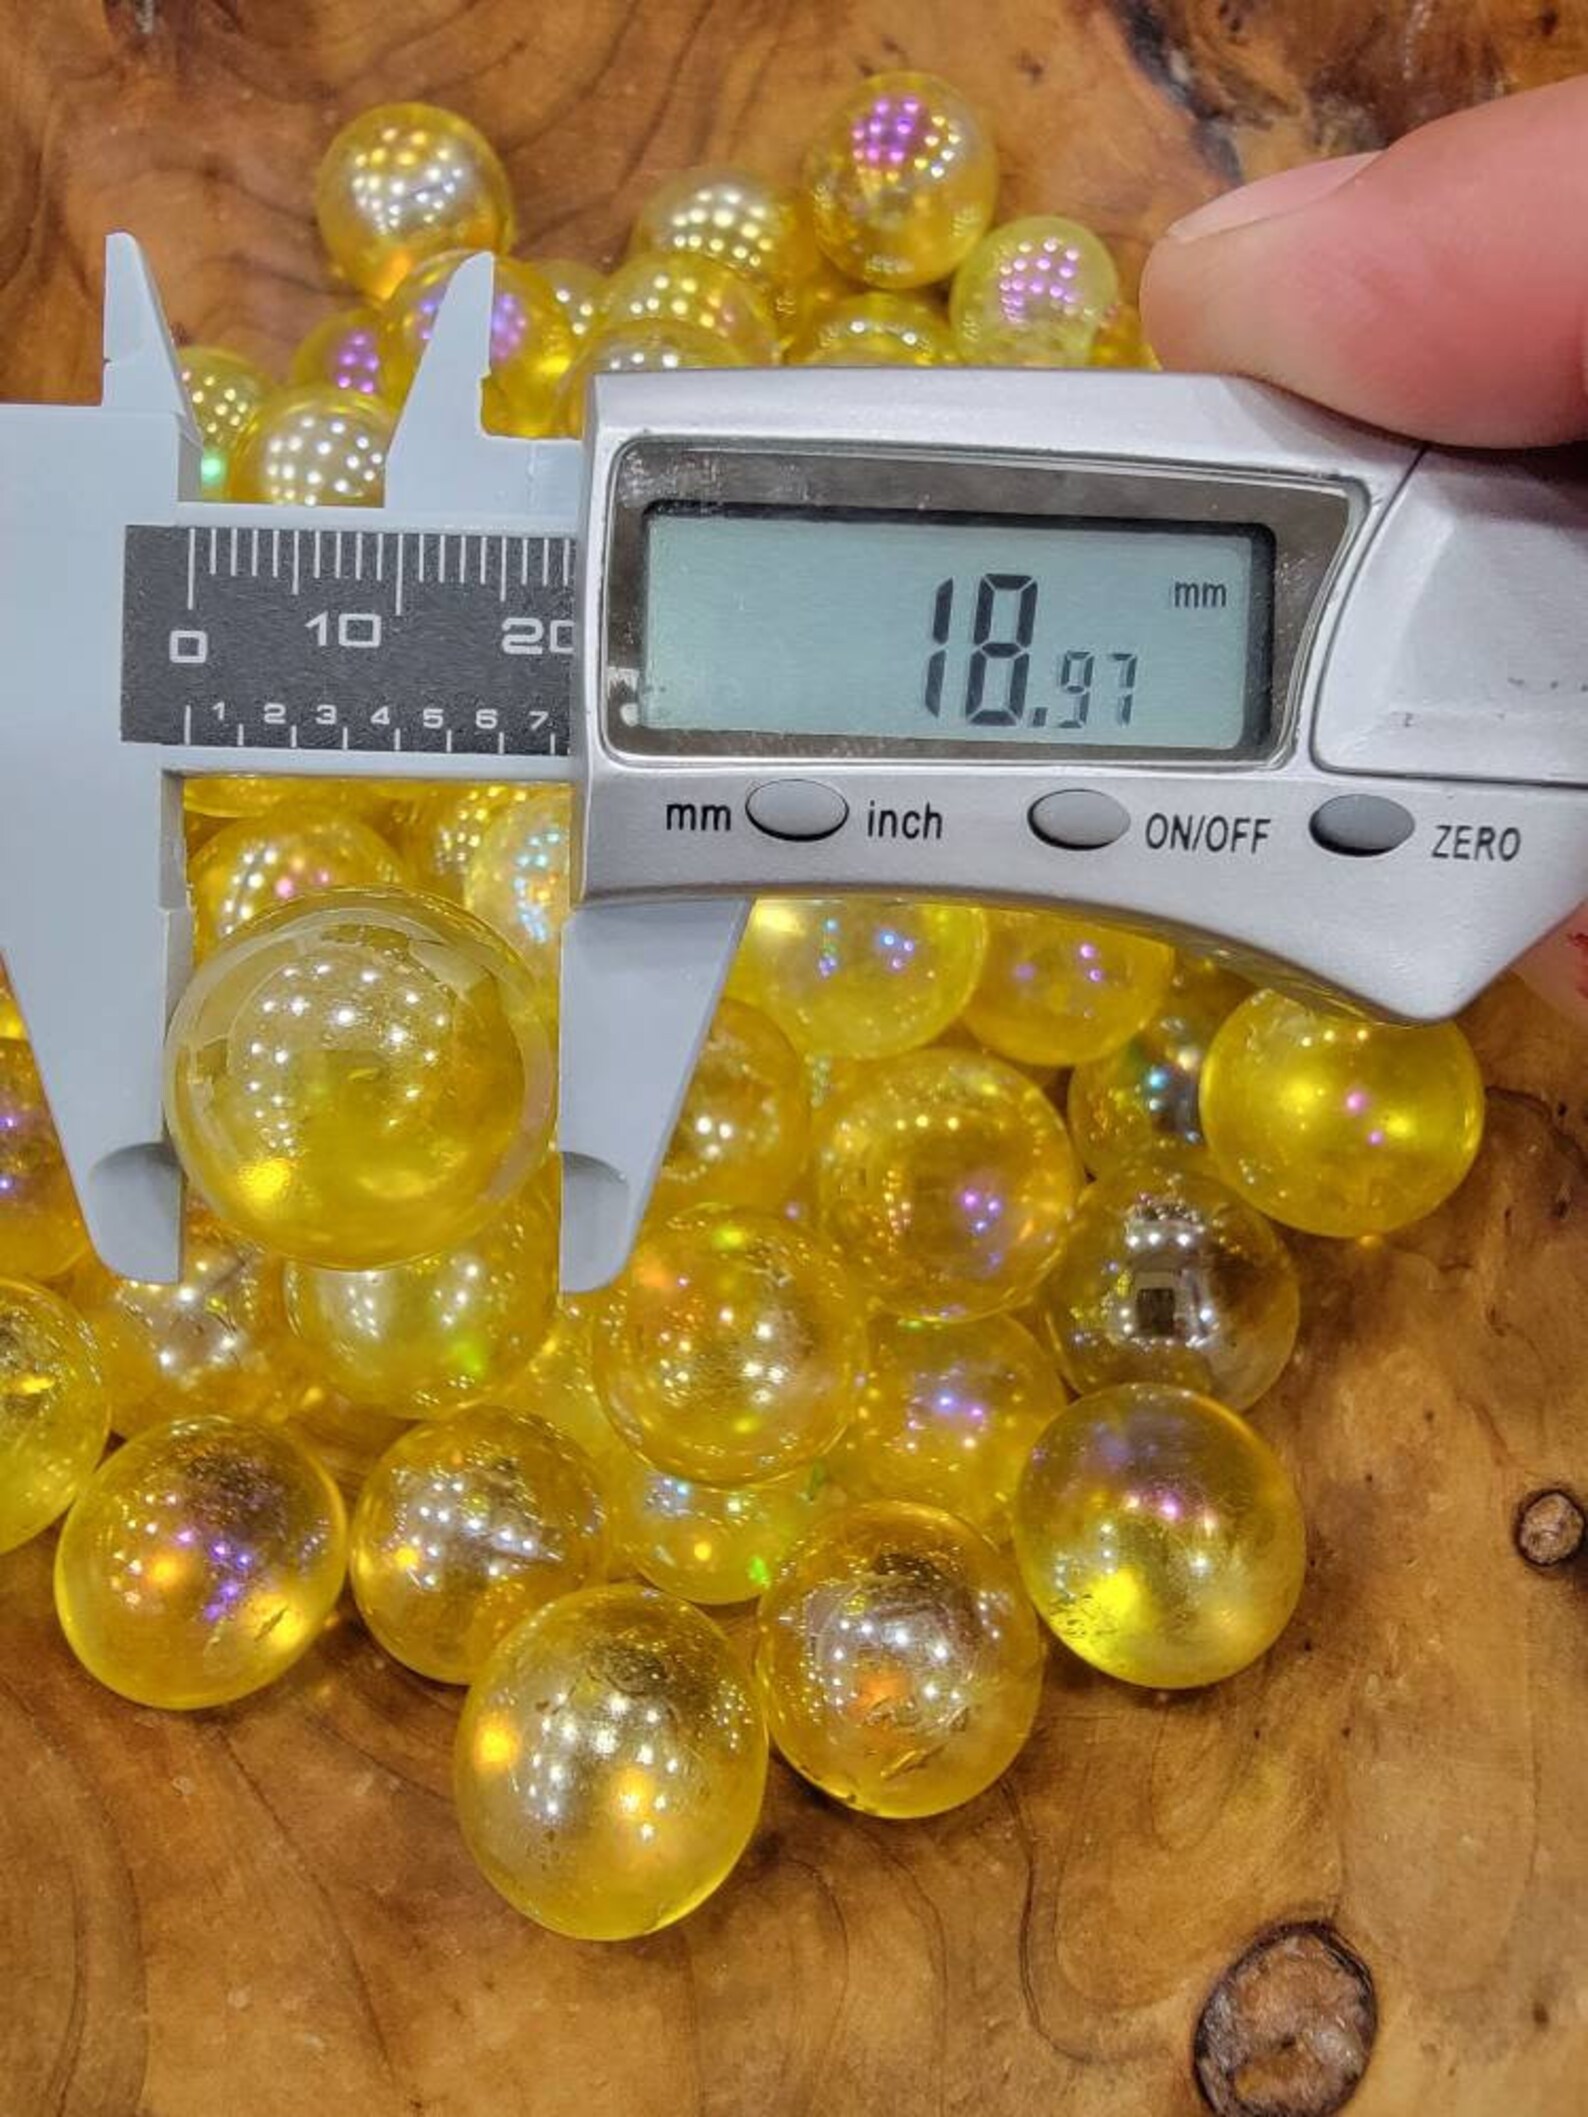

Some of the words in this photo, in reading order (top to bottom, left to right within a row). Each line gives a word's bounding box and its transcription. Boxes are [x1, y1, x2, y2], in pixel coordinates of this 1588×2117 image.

[1174, 579, 1227, 610] mm
[169, 630, 207, 663] 0
[304, 612, 382, 648] 10
[924, 573, 1137, 728] 18.97
[211, 701, 226, 720] 1
[264, 703, 287, 725] 2
[315, 704, 338, 726] 3
[369, 705, 391, 726] 4
[422, 708, 445, 729] 5
[475, 709, 499, 729] 6
[529, 710, 549, 731] 7
[665, 801, 733, 834] mm
[867, 801, 944, 840] inch
[1145, 814, 1272, 855] ON/OFF
[1431, 824, 1523, 862] ZERO
